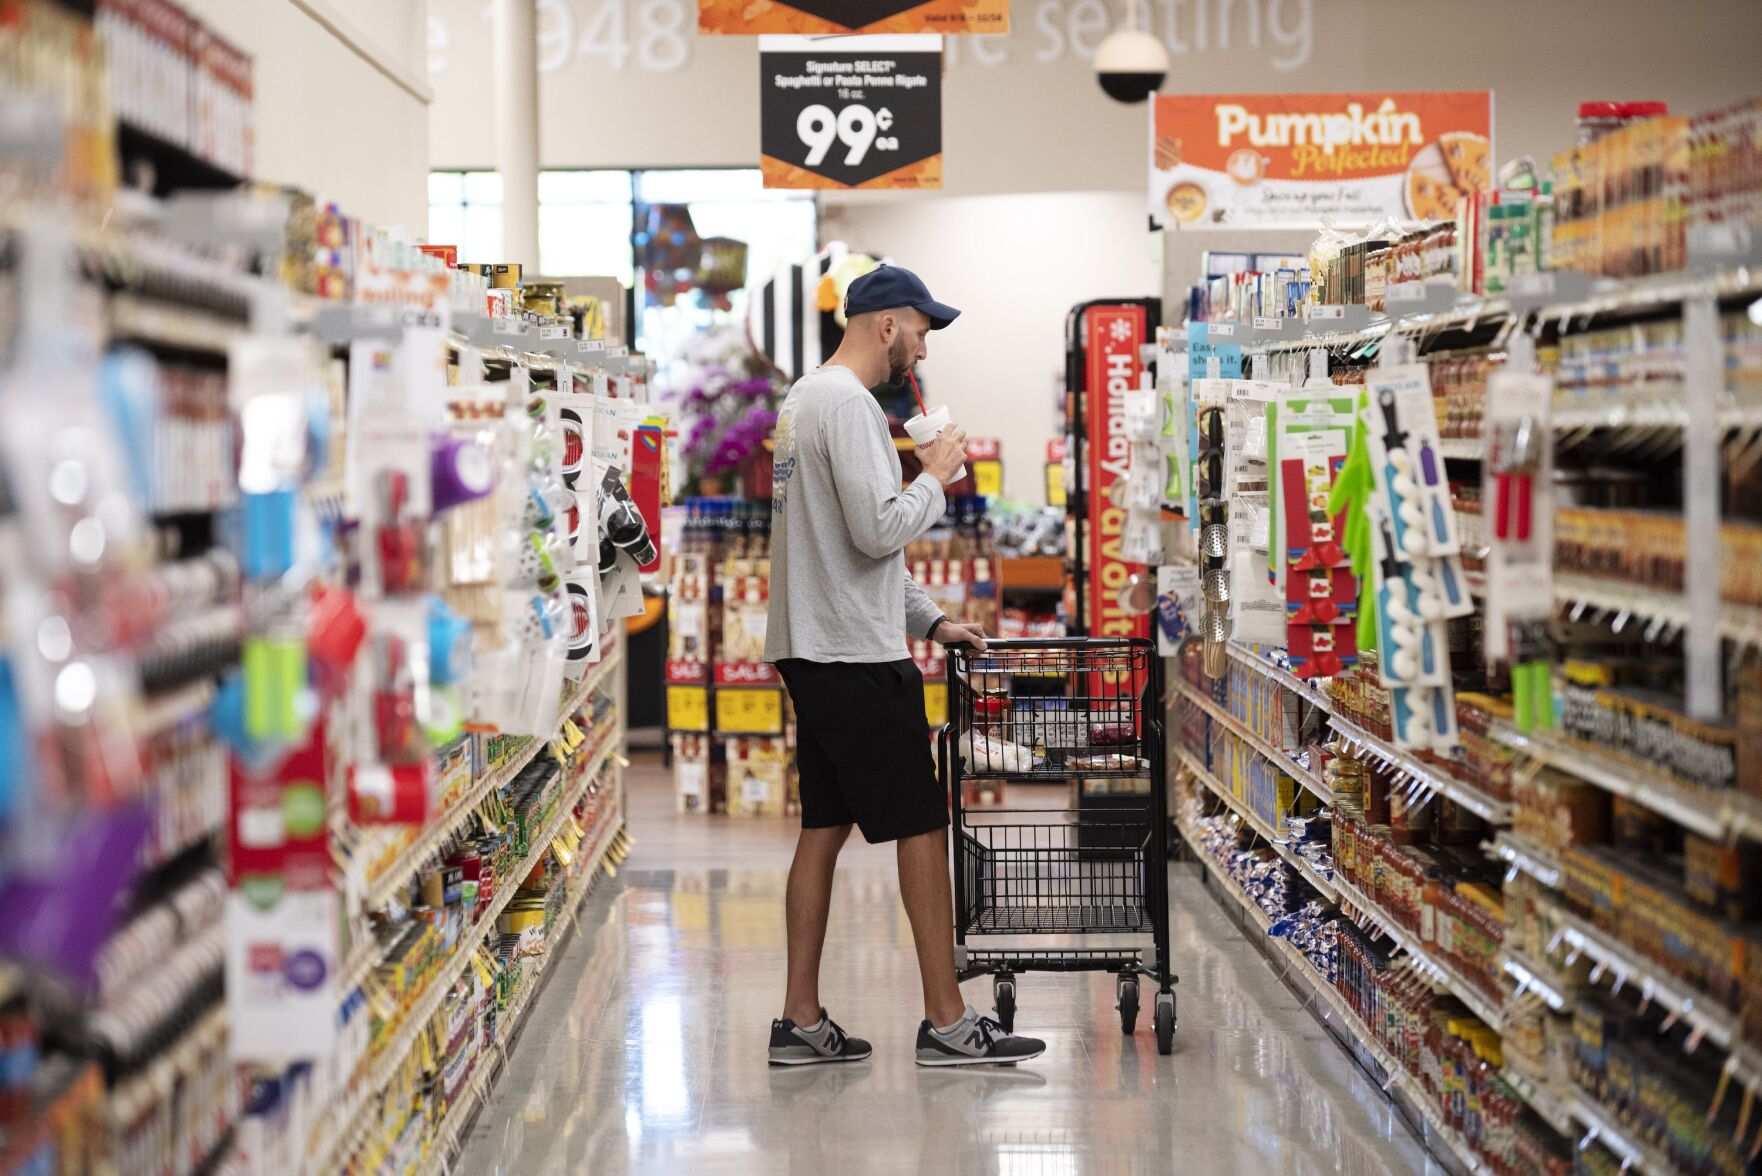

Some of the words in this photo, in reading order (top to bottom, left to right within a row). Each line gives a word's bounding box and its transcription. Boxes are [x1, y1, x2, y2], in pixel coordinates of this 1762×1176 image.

[806, 60, 853, 74] Signature
[775, 75, 822, 89] Spaghetti
[823, 77, 834, 86] or
[835, 75, 863, 87] Pasta
[864, 75, 894, 87] Penne
[895, 75, 928, 89] Rigate
[837, 88, 849, 98] 16
[1215, 97, 1423, 155] Pumpkin
[875, 136, 899, 151] ea
[1290, 139, 1409, 176] Perfected
[1100, 353, 1133, 480] Holiday
[1103, 486, 1134, 684] avorits
[723, 663, 770, 682] SALE
